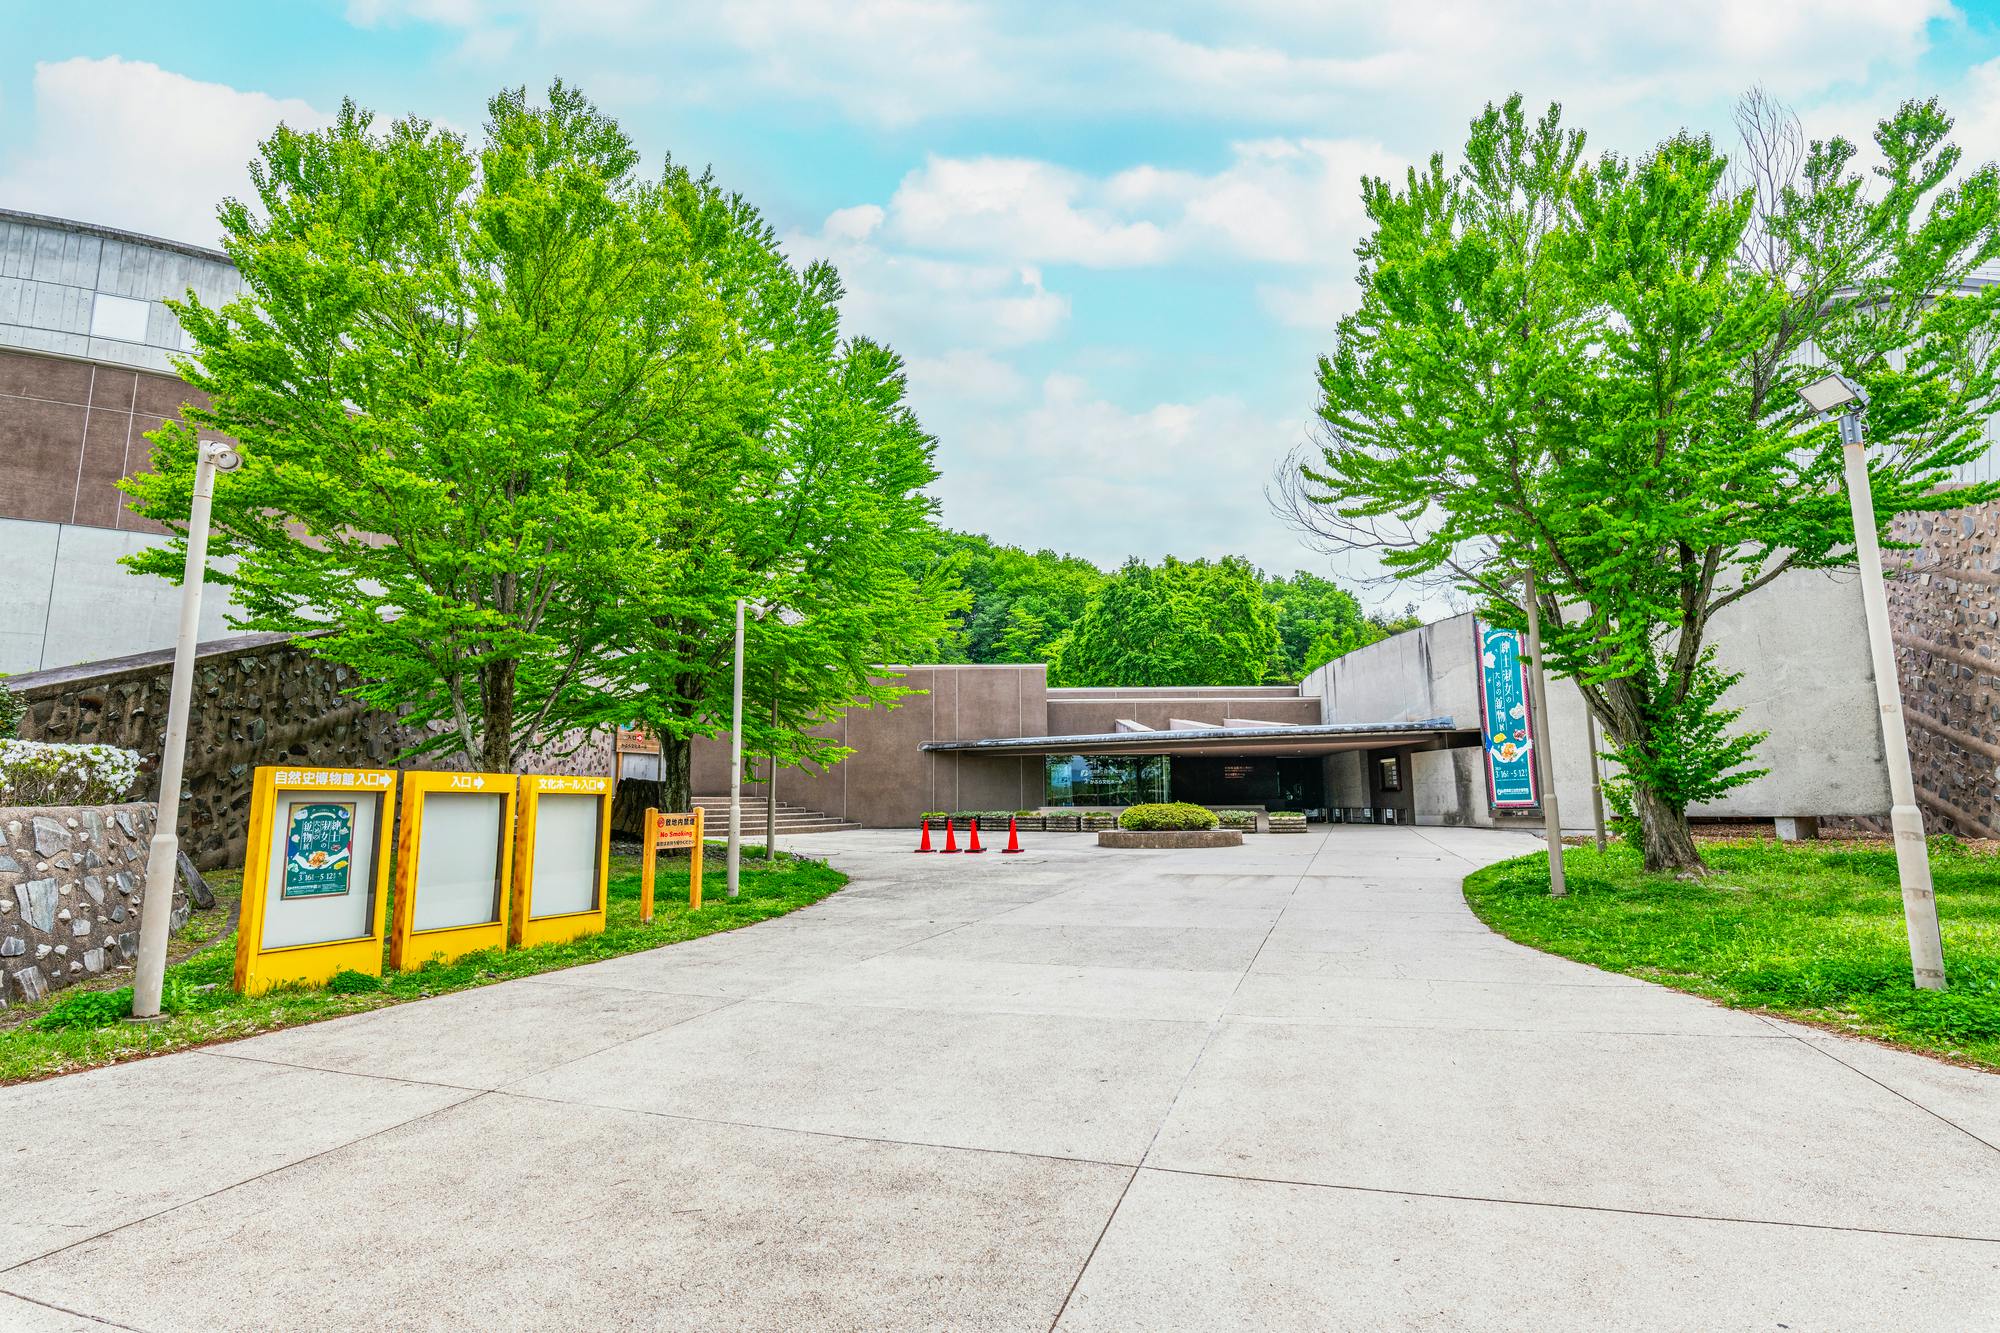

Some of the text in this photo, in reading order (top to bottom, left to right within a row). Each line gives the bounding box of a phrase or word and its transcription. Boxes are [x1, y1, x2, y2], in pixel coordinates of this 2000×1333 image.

[275, 771, 379, 786] 自然史博物館 入口
[450, 776, 471, 788] 入口
